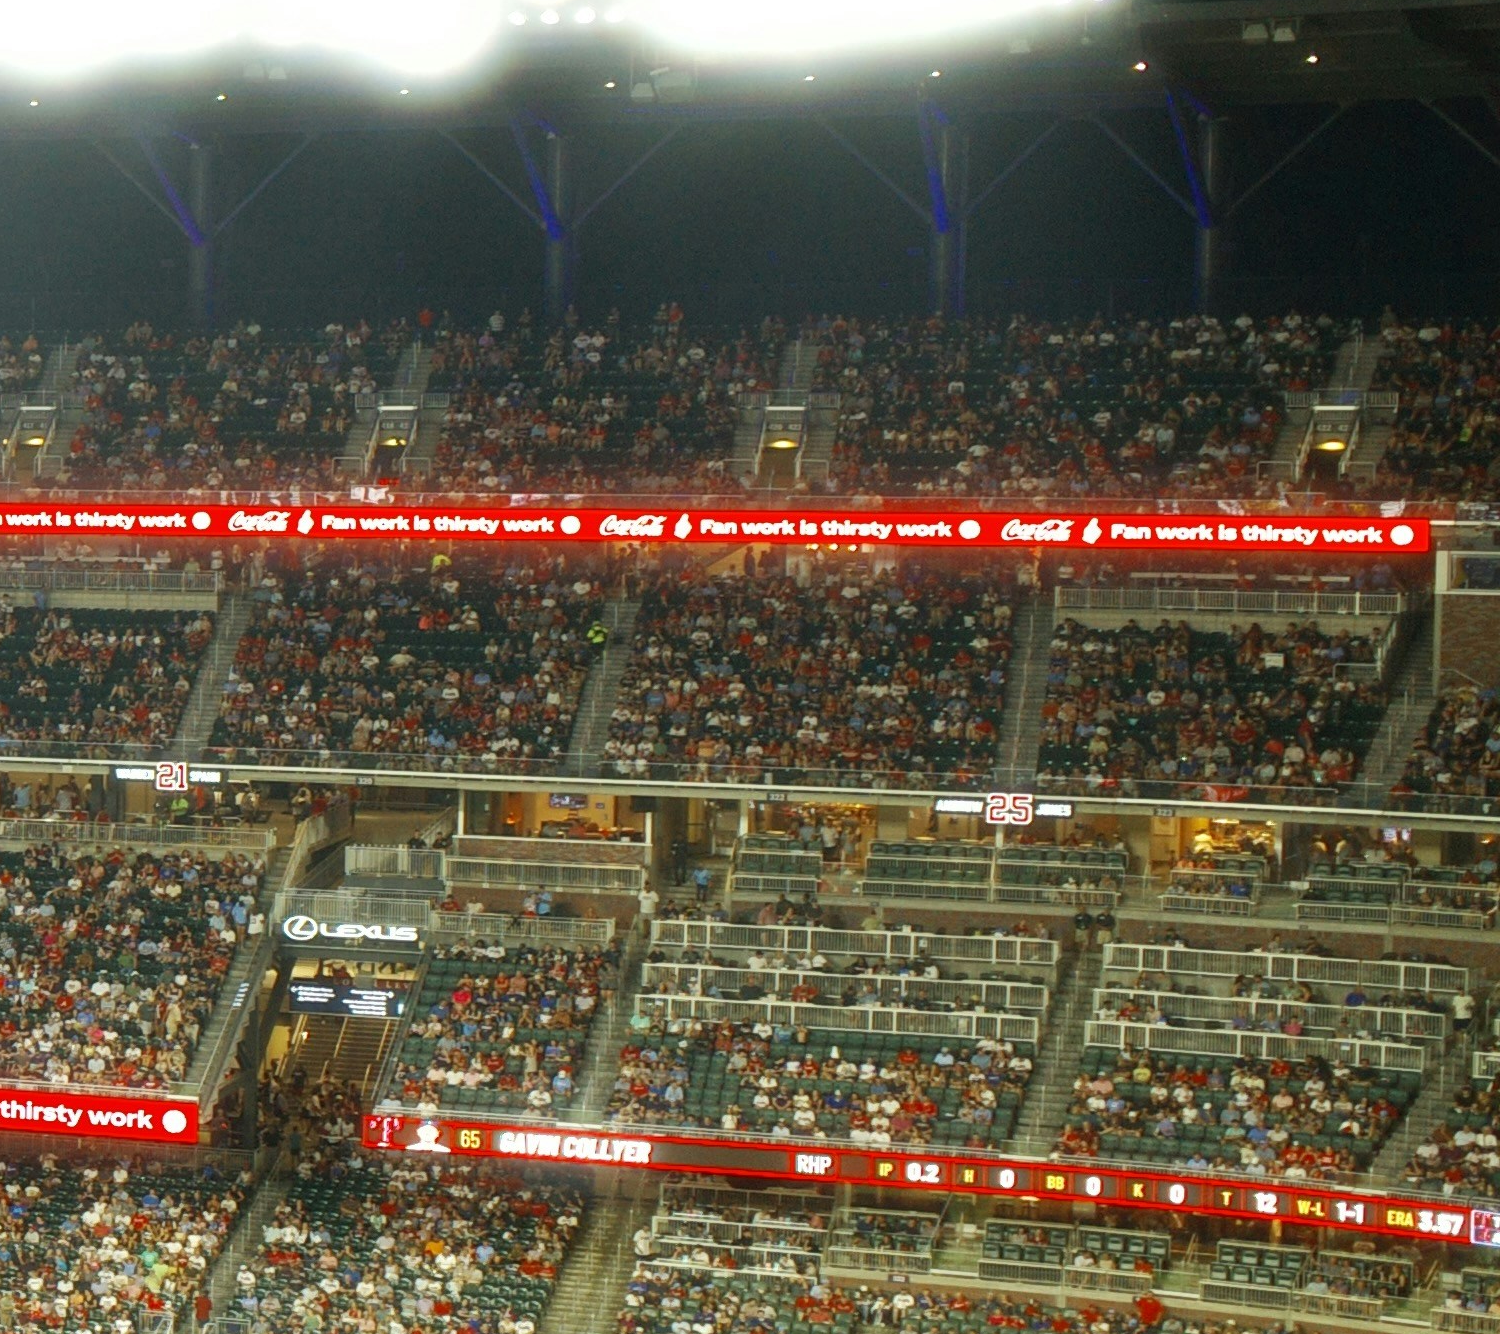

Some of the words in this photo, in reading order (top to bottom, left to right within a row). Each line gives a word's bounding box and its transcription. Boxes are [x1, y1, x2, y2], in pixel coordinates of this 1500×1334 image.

[1001, 518, 1074, 542] Coca-Cola
[1111, 524, 1151, 539] Fan
[1156, 525, 1213, 540] work
[1218, 524, 1237, 540] is
[1241, 525, 1318, 545] thirsty
[1322, 527, 1382, 543] work
[156, 763, 188, 791] 21
[986, 793, 1033, 824] 25
[319, 923, 418, 942] LEXUS
[0, 1101, 82, 1127] thirsty
[88, 1110, 152, 1128] work
[460, 1131, 480, 1148] 65
[500, 1133, 561, 1156] GAVIN
[563, 1137, 651, 1163] COLLYER
[796, 1155, 832, 1175] RHP
[879, 1162, 893, 1176] IP
[907, 1162, 940, 1183] 0.2
[964, 1169, 974, 1182] H
[1000, 1170, 1014, 1188] 0
[1046, 1176, 1065, 1190] BB
[1086, 1176, 1101, 1195] 0
[1133, 1184, 1143, 1197] K
[1169, 1184, 1185, 1204] 0
[1222, 1192, 1232, 1206] T
[1255, 1193, 1278, 1213] 12
[1297, 1200, 1325, 1216] W-L
[1336, 1203, 1364, 1223] 1-1
[1387, 1210, 1414, 1227] ERA
